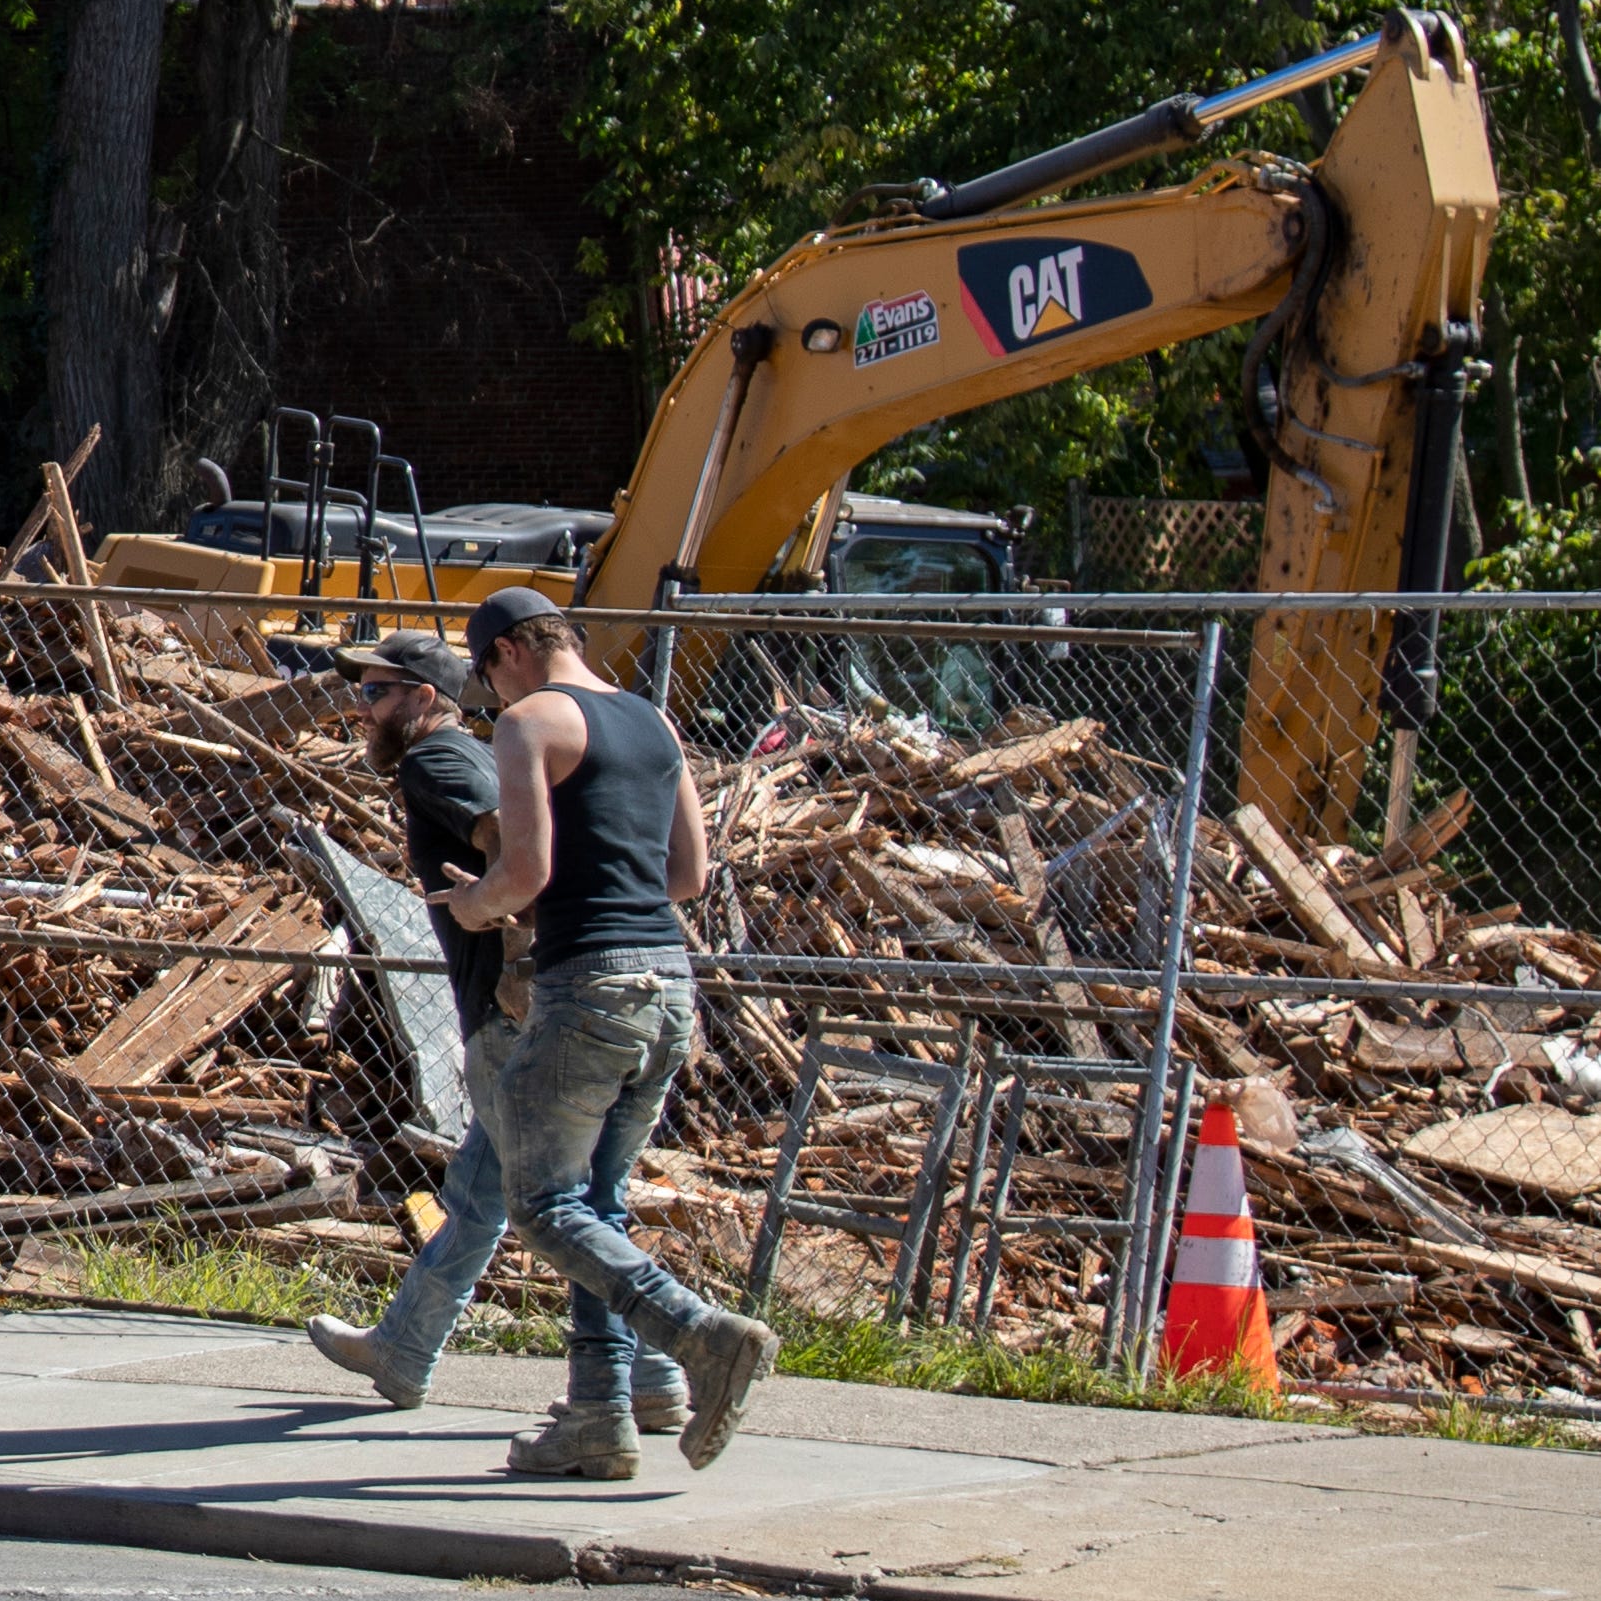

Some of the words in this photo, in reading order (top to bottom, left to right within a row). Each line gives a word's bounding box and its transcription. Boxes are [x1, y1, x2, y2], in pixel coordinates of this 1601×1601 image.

[1009, 246, 1084, 341] CAT
[873, 297, 930, 332] Evans
[857, 325, 936, 363] 271-1119
